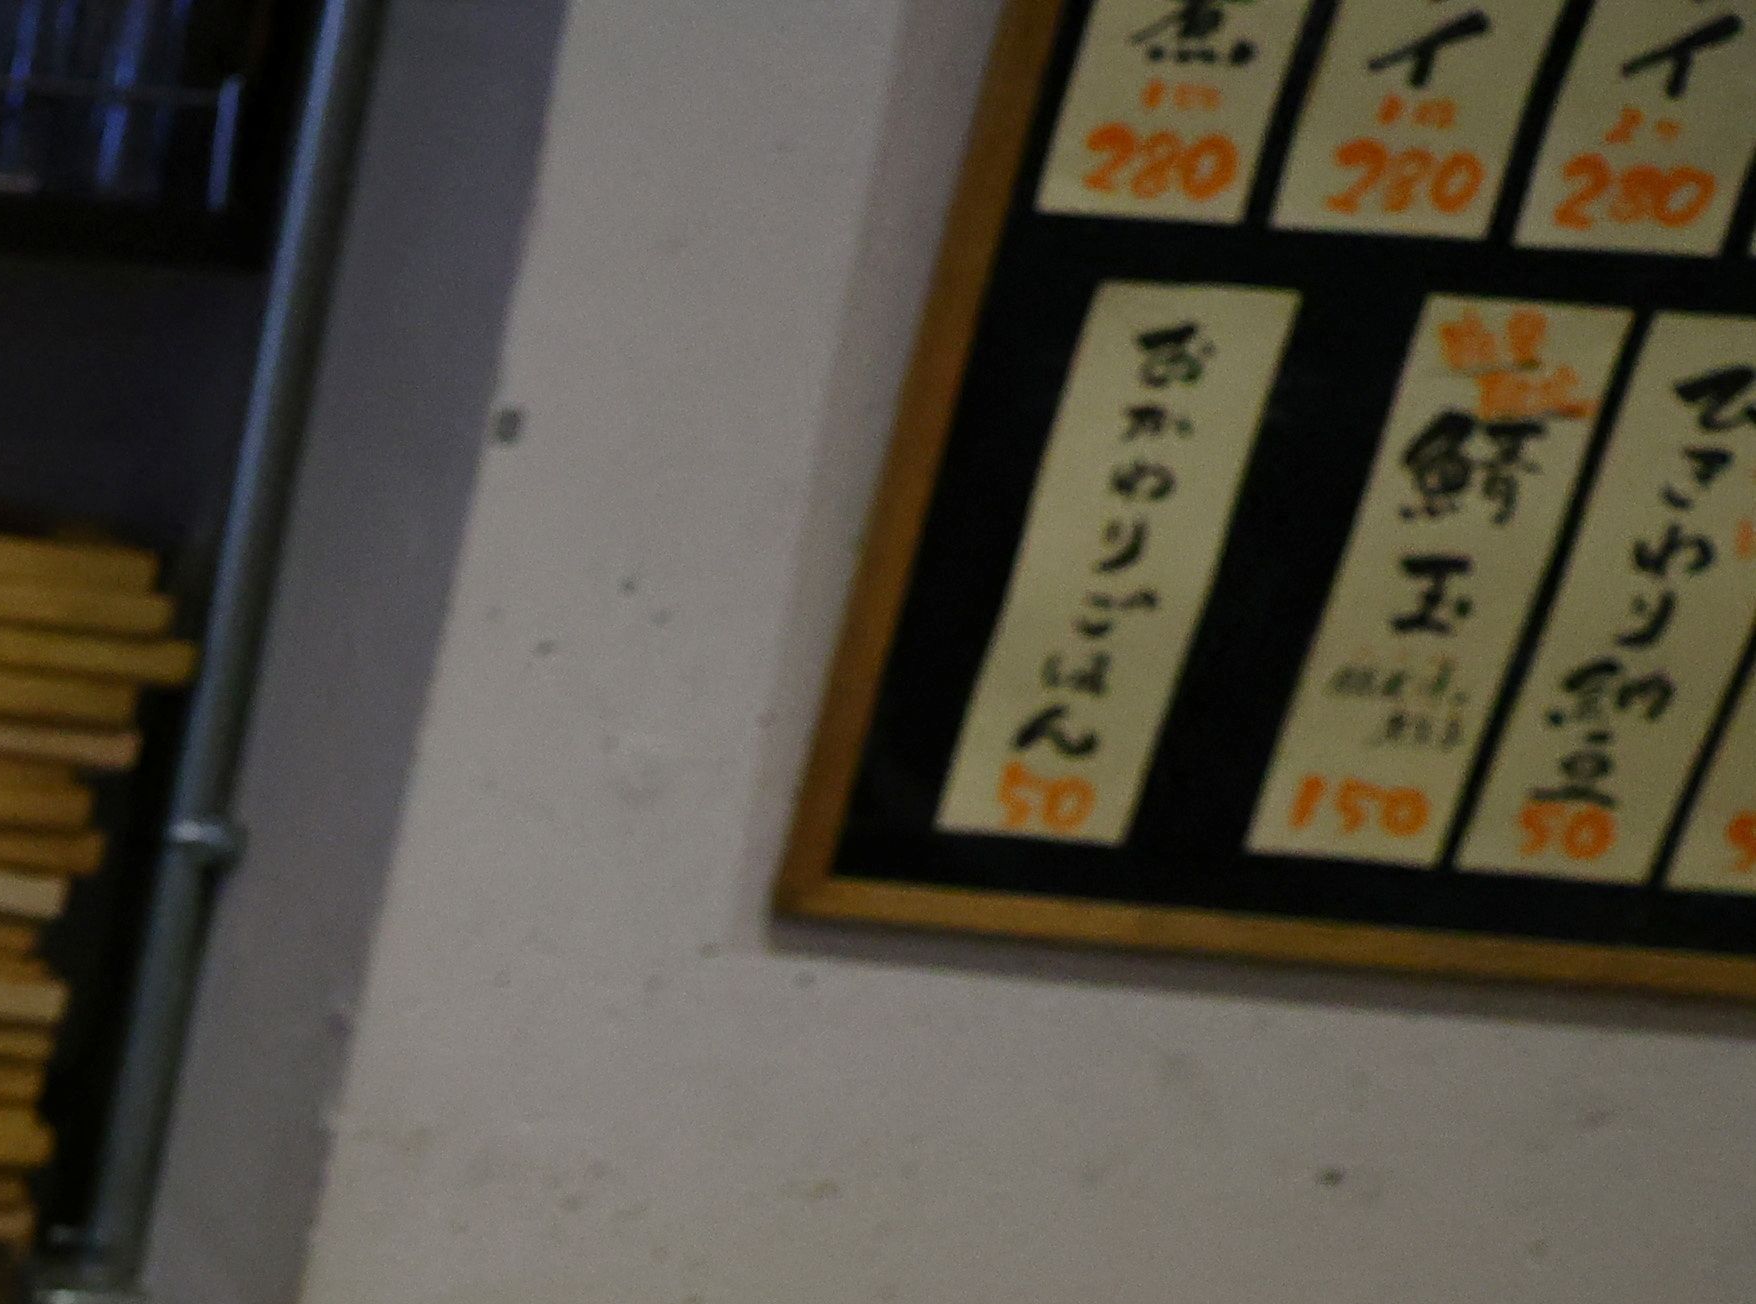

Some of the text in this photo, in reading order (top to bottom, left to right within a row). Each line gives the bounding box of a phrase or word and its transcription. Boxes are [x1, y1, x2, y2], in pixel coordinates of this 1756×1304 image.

[1084, 122, 1239, 200] 280
[1326, 138, 1485, 214] 280
[998, 760, 1095, 835] 50
[1291, 774, 1429, 836] 150
[1518, 802, 1617, 860] 50
